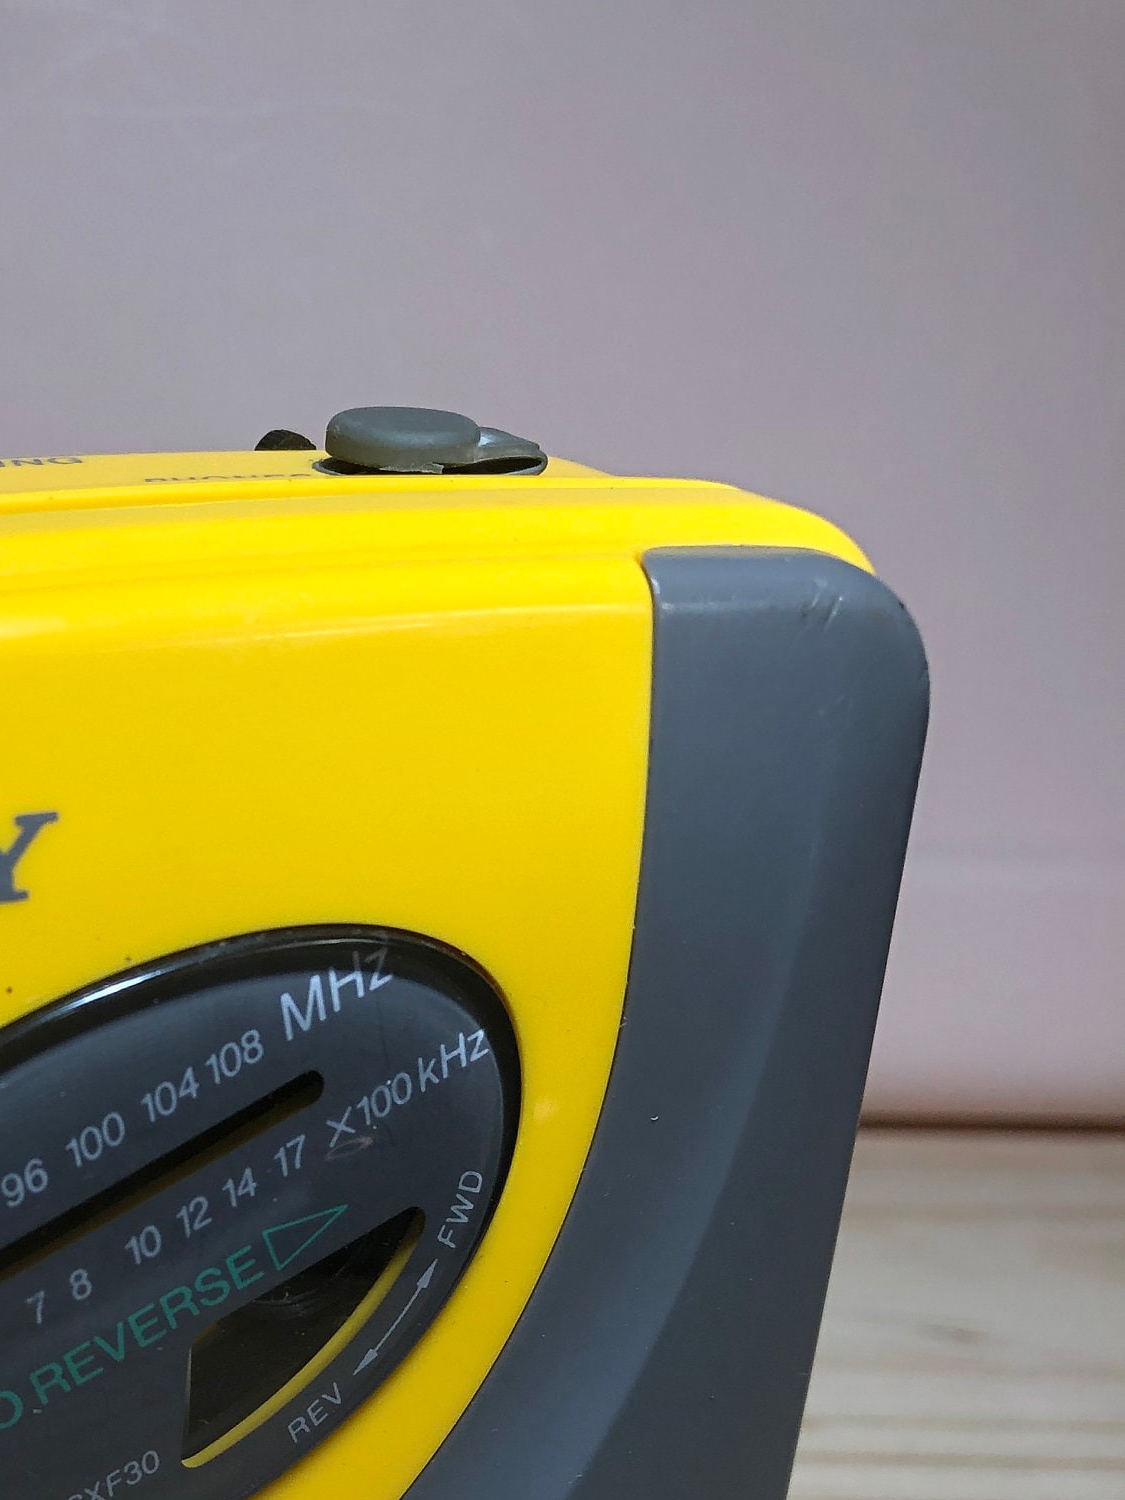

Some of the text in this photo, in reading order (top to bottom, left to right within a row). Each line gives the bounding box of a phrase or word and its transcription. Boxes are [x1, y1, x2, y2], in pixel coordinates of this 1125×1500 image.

[0, 1158, 49, 1207] 96
[65, 1111, 126, 1167] 100
[141, 1066, 200, 1122] 104
[205, 1029, 264, 1085] 108
[280, 948, 394, 1041] MHz
[27, 1290, 45, 1324] 7
[69, 1268, 92, 1300] 8
[124, 1225, 162, 1265] 10
[176, 1196, 213, 1238] 12
[222, 1167, 257, 1207] 14
[274, 1133, 306, 1177] 17
[437, 1170, 483, 1249] FWD
[28, 1245, 265, 1405] REVERSE
[287, 1382, 343, 1443] REV
